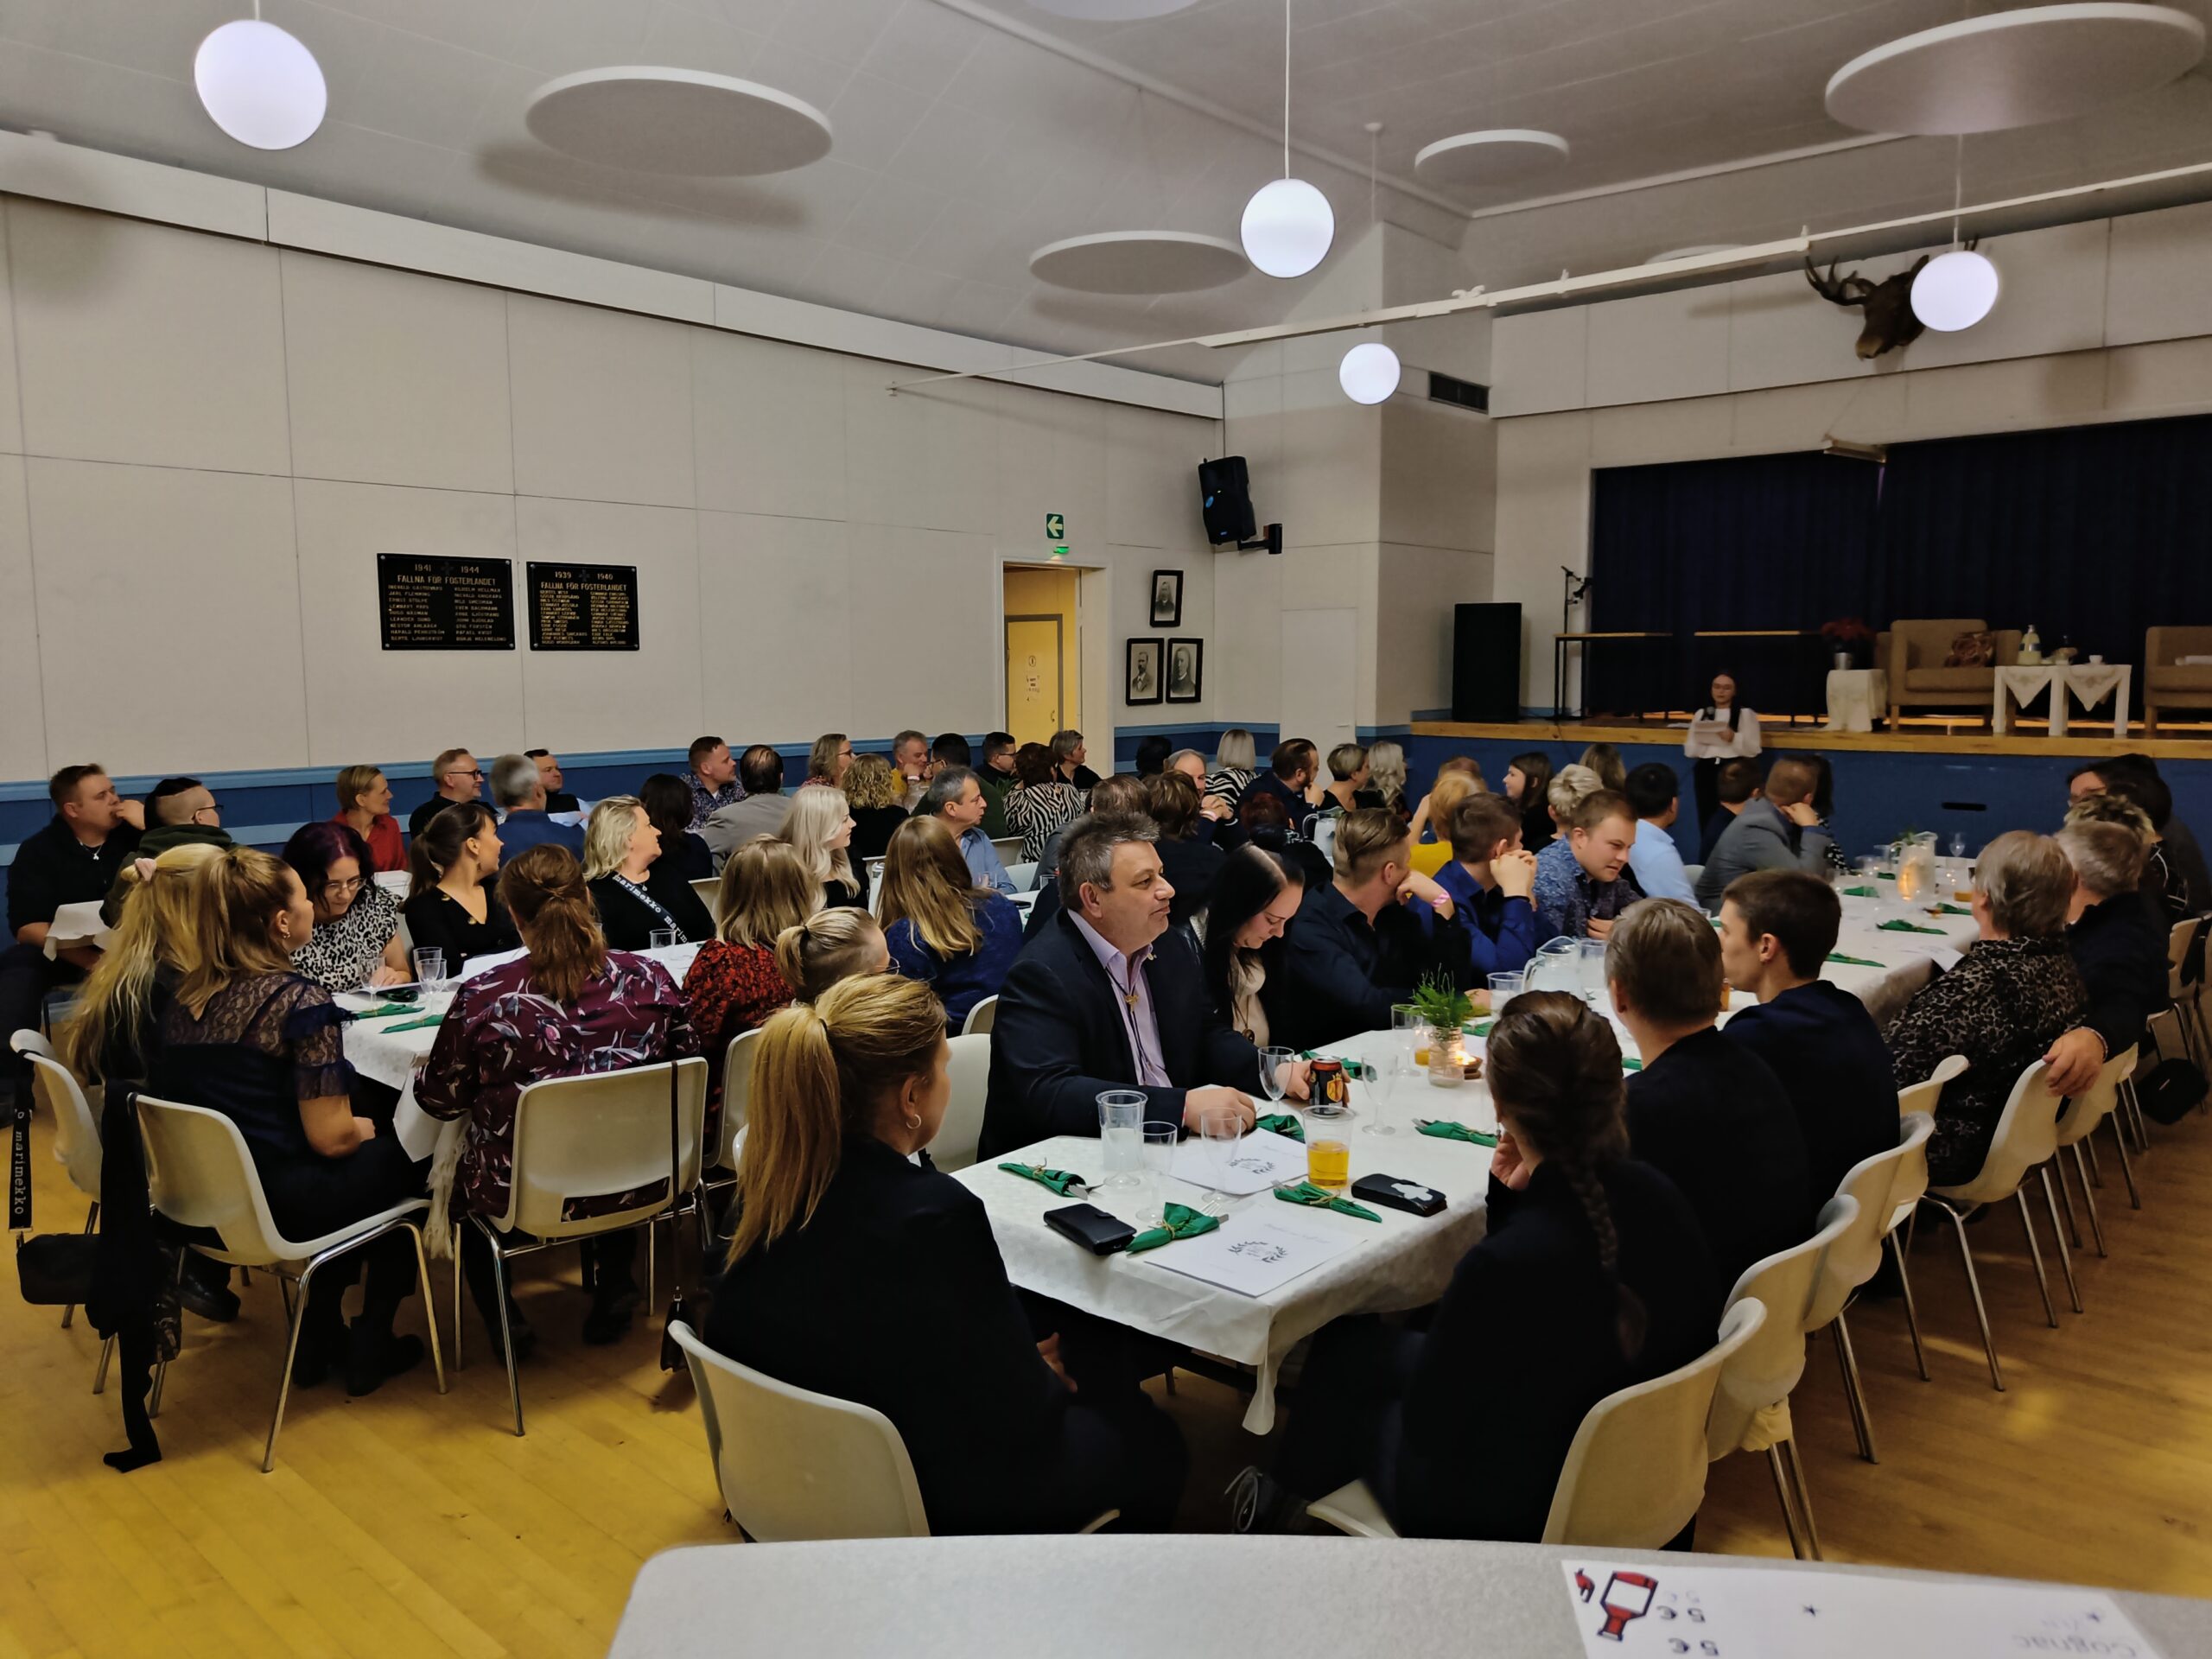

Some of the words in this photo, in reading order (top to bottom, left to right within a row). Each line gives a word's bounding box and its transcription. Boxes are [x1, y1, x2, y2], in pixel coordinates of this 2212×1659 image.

[415, 563, 431, 572] 1941
[397, 575, 425, 583] FALLNA
[445, 575, 496, 586] FOSTERLANDET
[612, 874, 662, 913] marimekko
[14, 1130, 27, 1215] marimekko
[2011, 1635, 2138, 1658] Cognac
